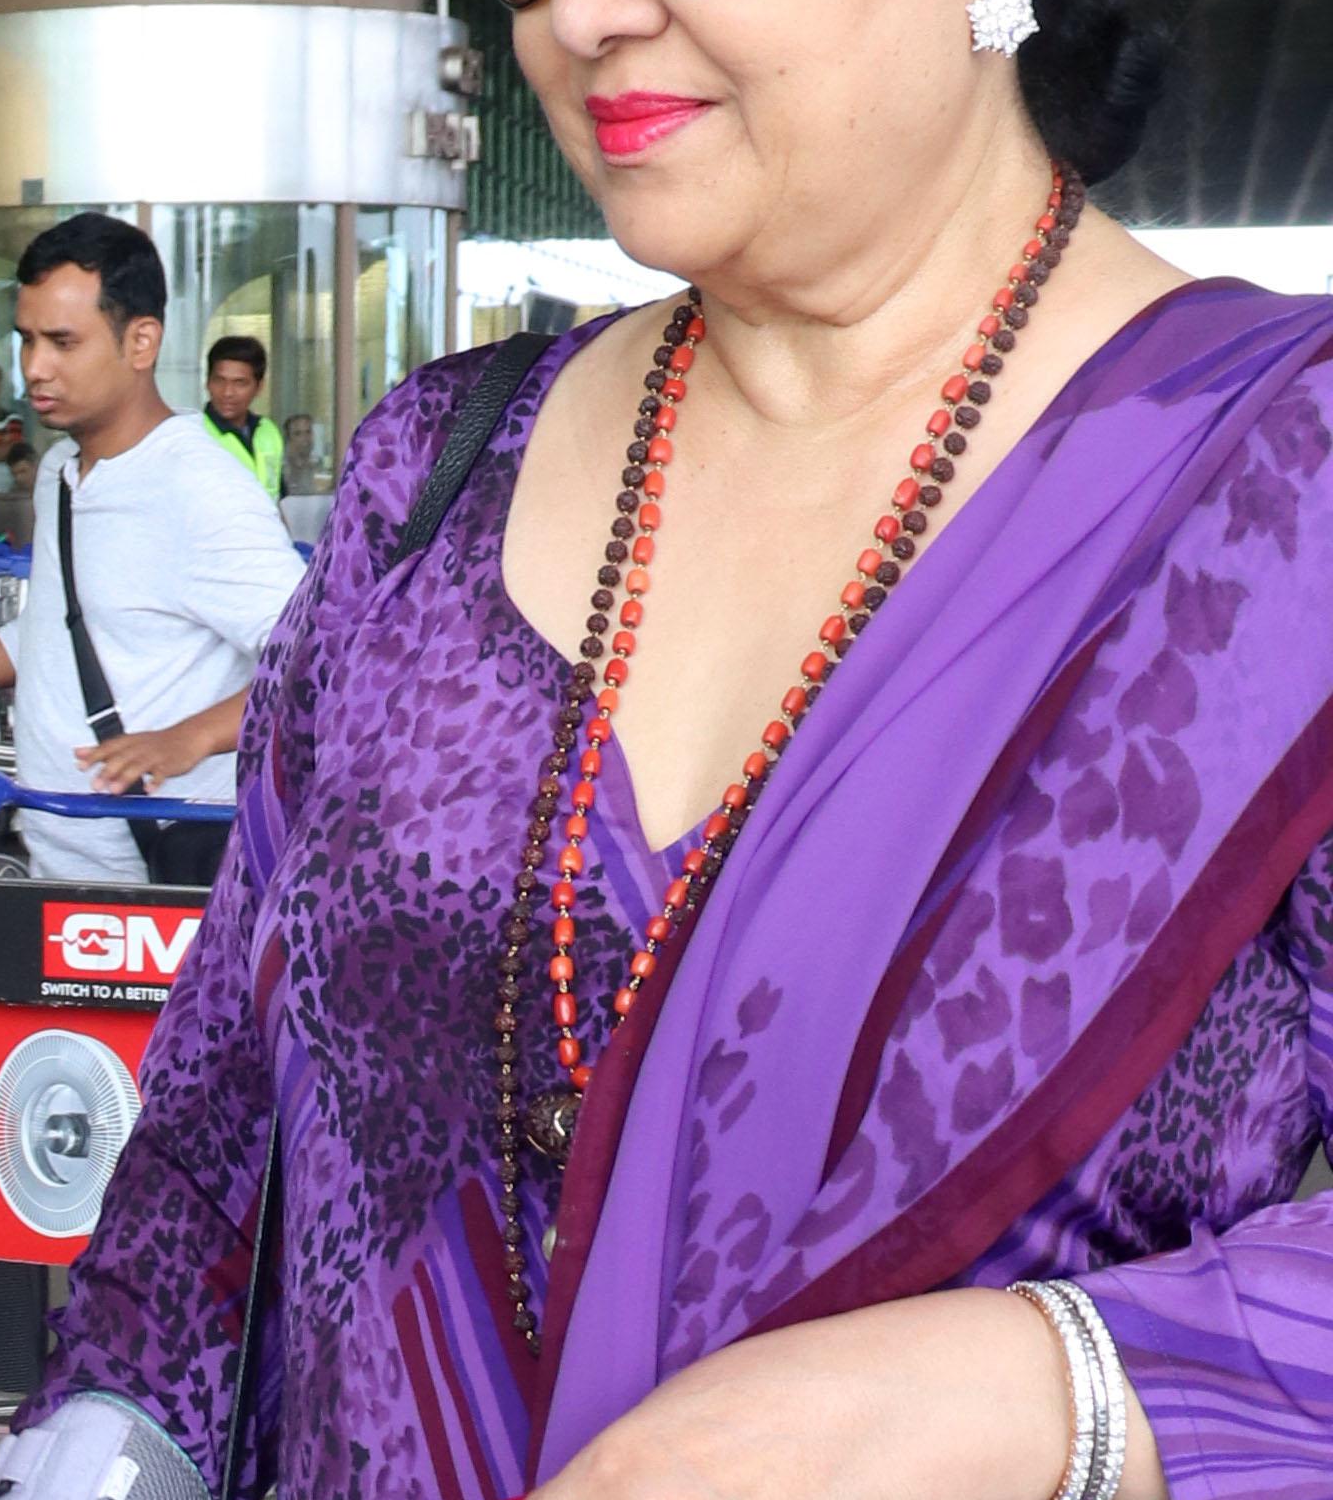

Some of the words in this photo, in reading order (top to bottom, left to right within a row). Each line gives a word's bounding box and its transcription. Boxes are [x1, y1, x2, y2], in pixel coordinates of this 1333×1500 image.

[48, 913, 202, 974] GM
[41, 982, 90, 998] SWITCH
[92, 985, 111, 999] TO
[113, 987, 124, 999] A
[126, 987, 170, 1002] BETTER
